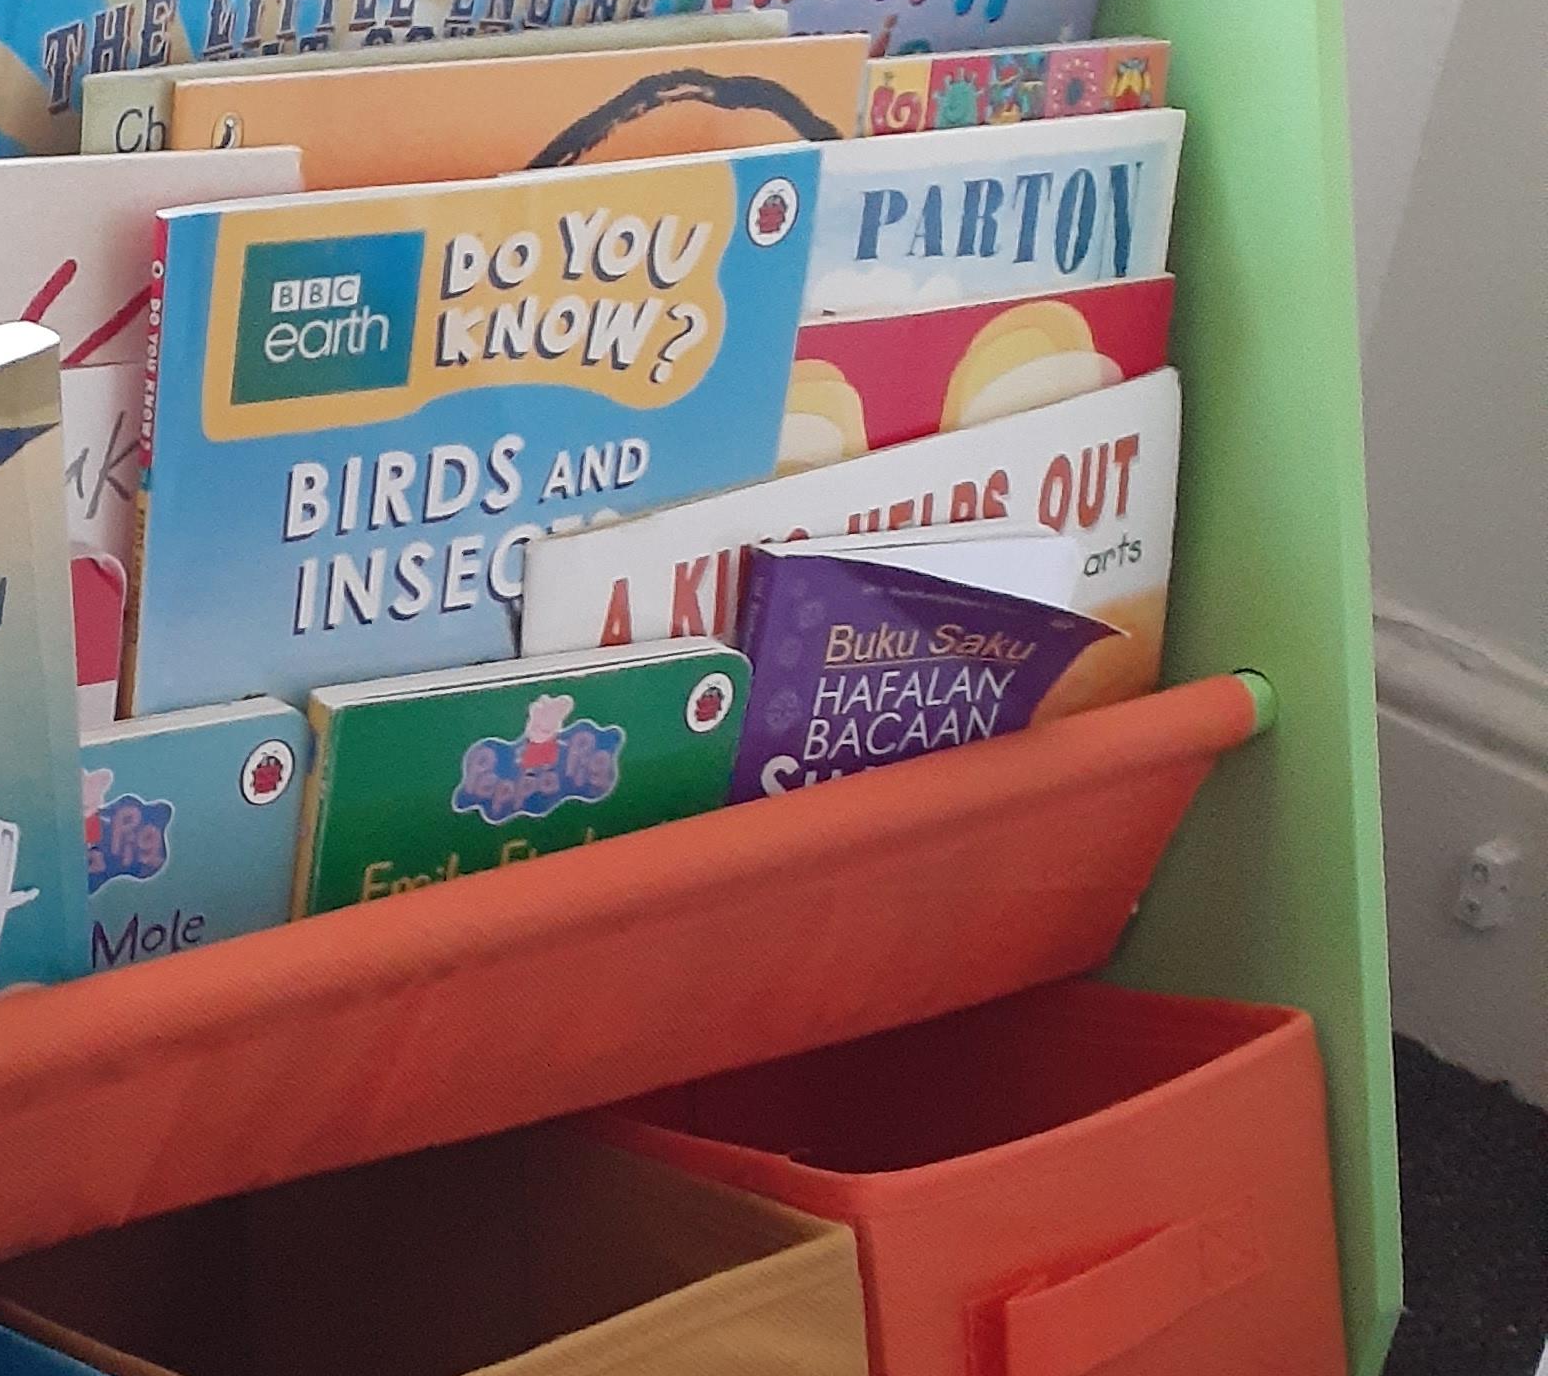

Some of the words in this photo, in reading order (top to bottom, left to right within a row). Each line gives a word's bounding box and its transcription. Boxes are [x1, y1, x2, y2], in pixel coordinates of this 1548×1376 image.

[854, 161, 1144, 279] PARTON
[440, 231, 542, 300] DO
[558, 207, 713, 290] YOU
[273, 274, 360, 311] BBC
[263, 305, 389, 363] earth
[435, 293, 709, 384] KNOW?
[282, 433, 525, 542] BIRDS
[537, 437, 651, 505] AND
[599, 577, 635, 647] A
[1037, 432, 1140, 535] OUT
[292, 508, 621, 636] INSEC
[825, 622, 920, 664] Buku
[927, 625, 1037, 663] Saku
[812, 665, 1017, 717] HAFALAN
[566, 729, 613, 788] Pig
[803, 703, 1001, 762] BACAAN
[110, 805, 164, 869] Pig
[91, 908, 207, 969] Mole
